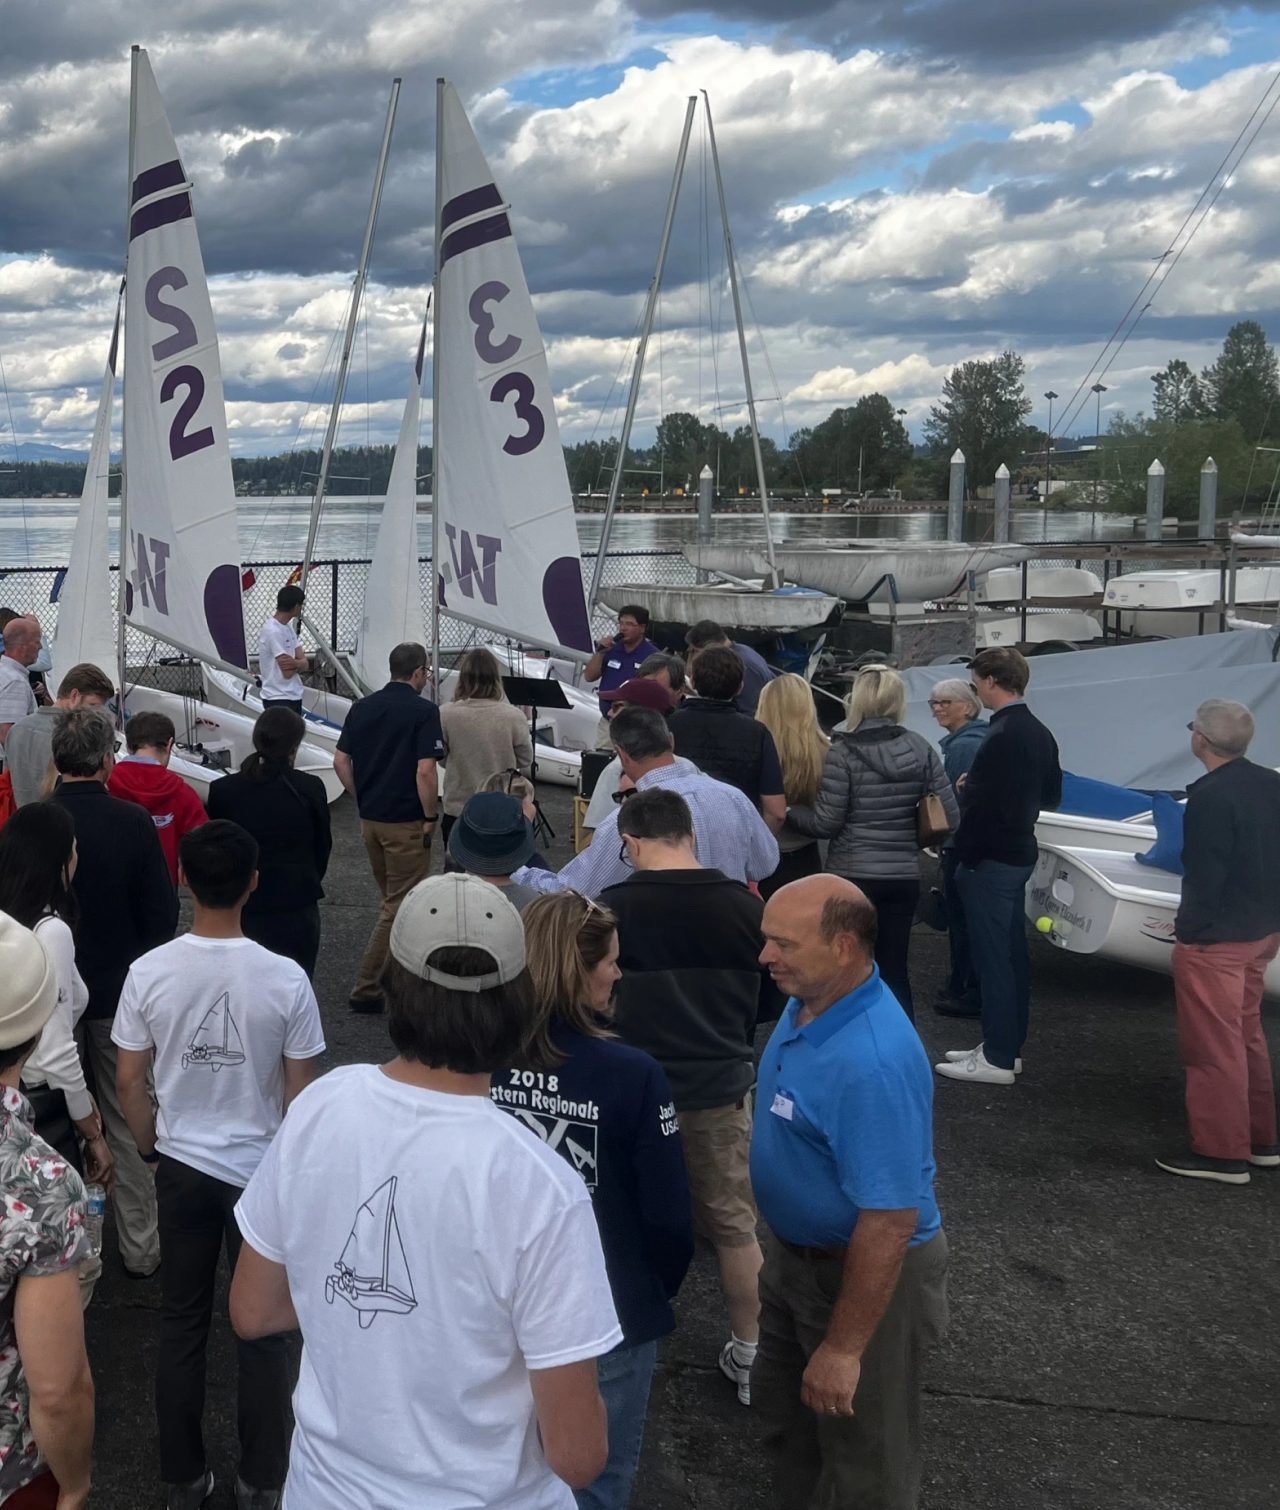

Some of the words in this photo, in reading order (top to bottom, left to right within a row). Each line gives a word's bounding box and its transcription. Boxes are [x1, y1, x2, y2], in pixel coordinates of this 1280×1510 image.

[160, 364, 215, 461] 2
[489, 372, 545, 457] 3
[488, 1085, 527, 1106] stern
[531, 1089, 599, 1121] Regionals
[509, 1068, 559, 1092] 2018
